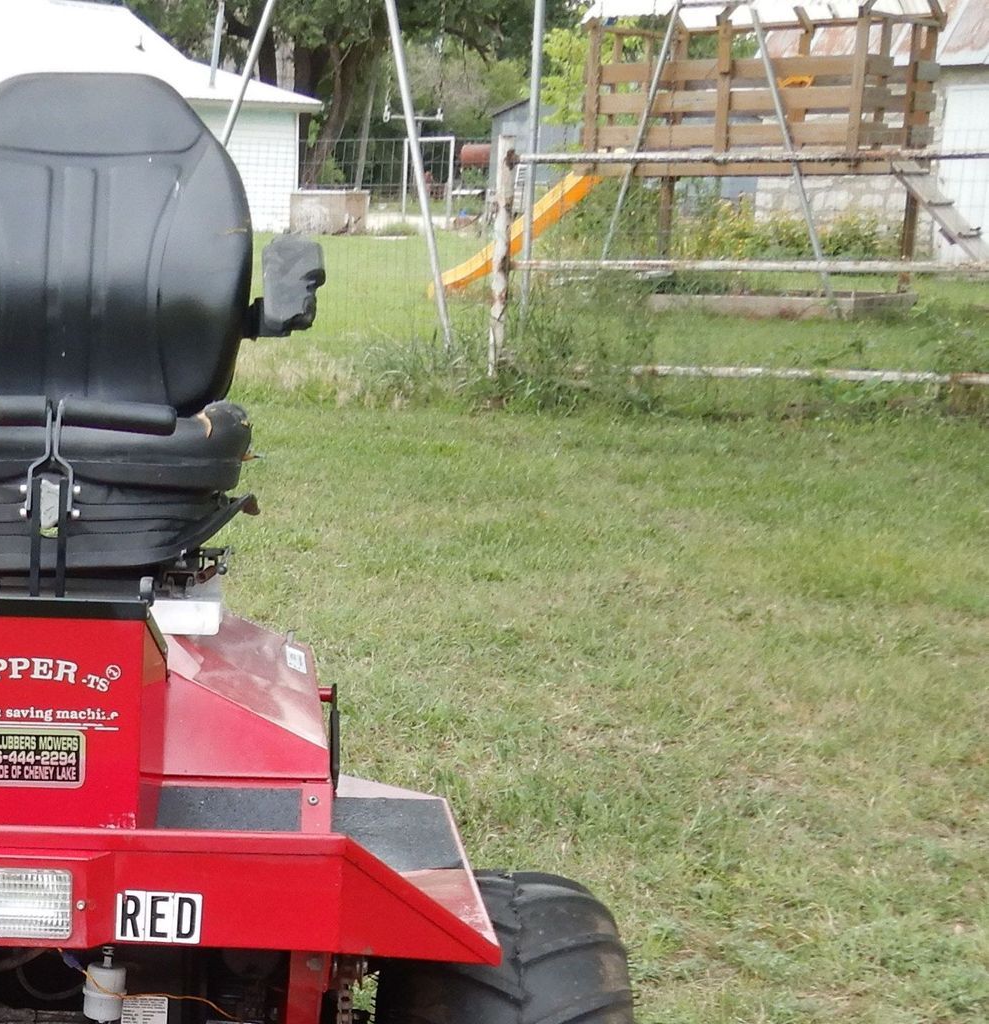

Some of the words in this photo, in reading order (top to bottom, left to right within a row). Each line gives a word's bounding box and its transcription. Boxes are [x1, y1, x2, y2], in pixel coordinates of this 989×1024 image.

[6, 706, 53, 721] saving
[39, 736, 79, 752] MOWERS
[11, 765, 22, 779] OF
[24, 766, 55, 780] CHENEY
[56, 766, 77, 780] LAKE
[121, 894, 198, 939] RED
